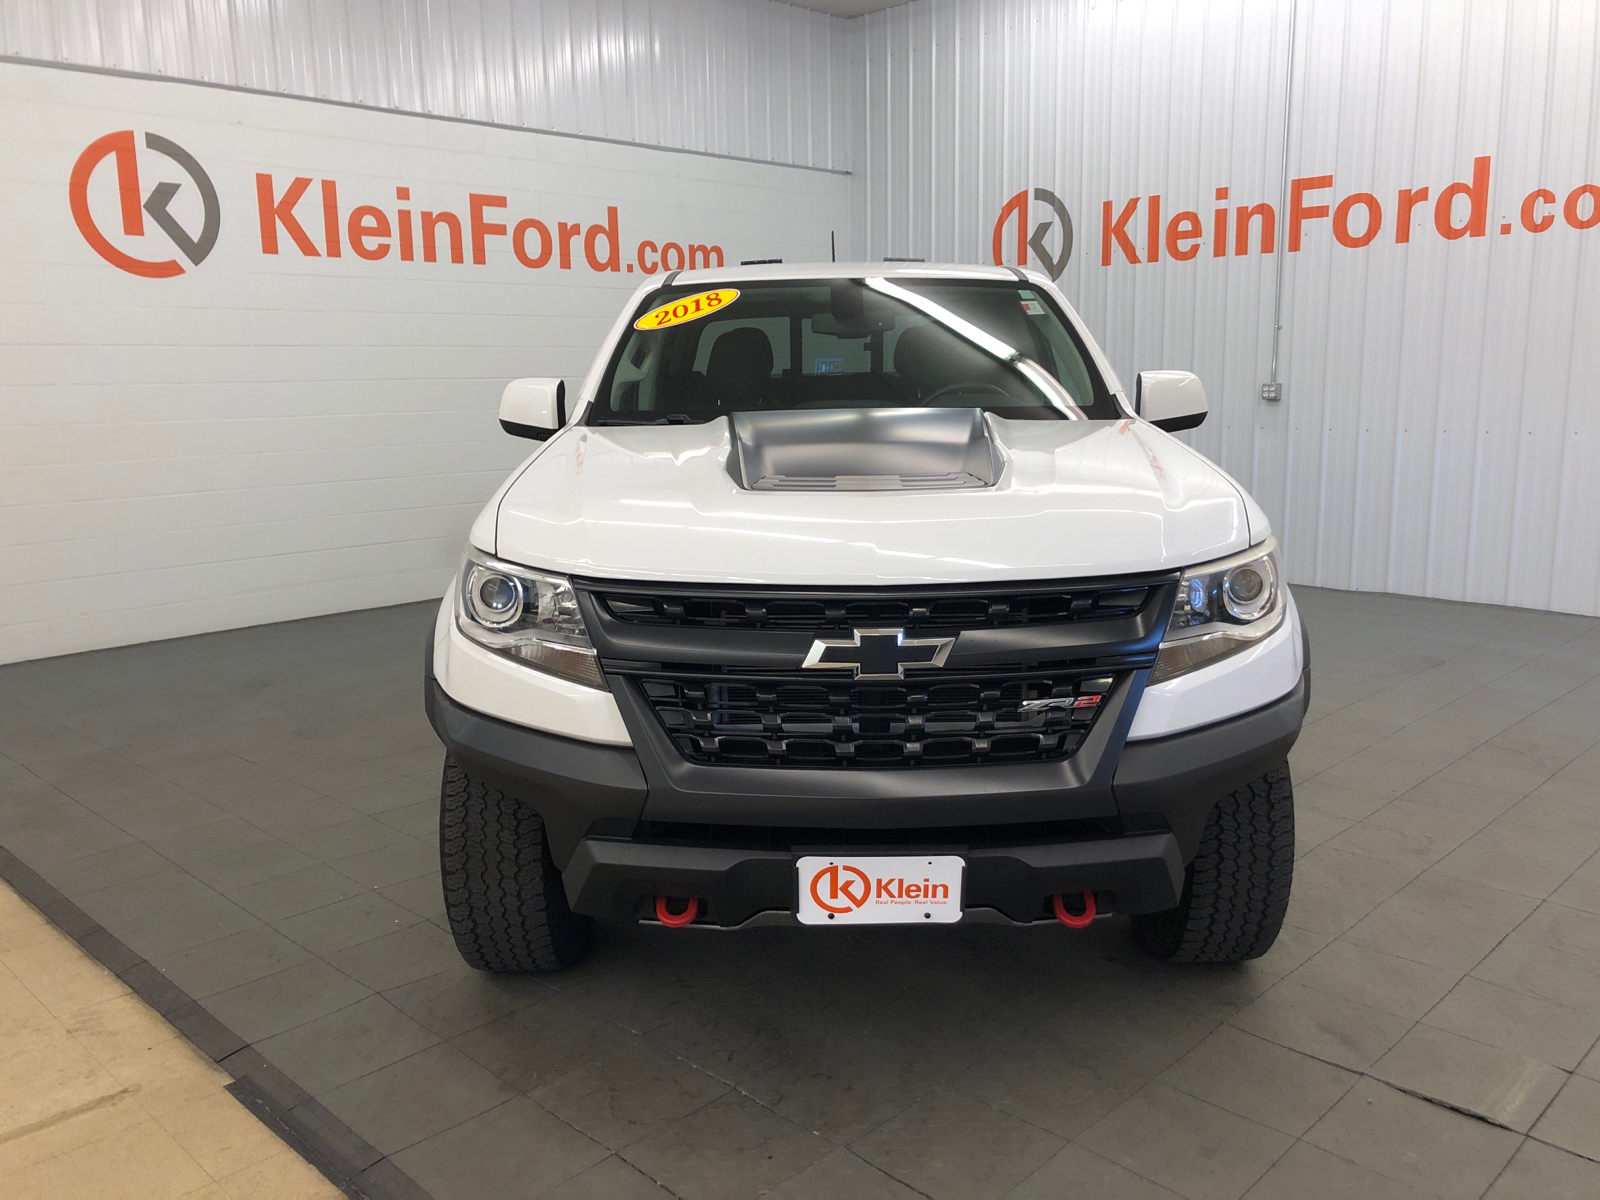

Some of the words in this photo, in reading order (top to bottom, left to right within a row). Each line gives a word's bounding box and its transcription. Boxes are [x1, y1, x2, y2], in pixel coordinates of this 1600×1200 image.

[255, 172, 725, 276] KleinFord.com
[654, 292, 723, 326] 2018
[875, 878, 949, 899] Klein
